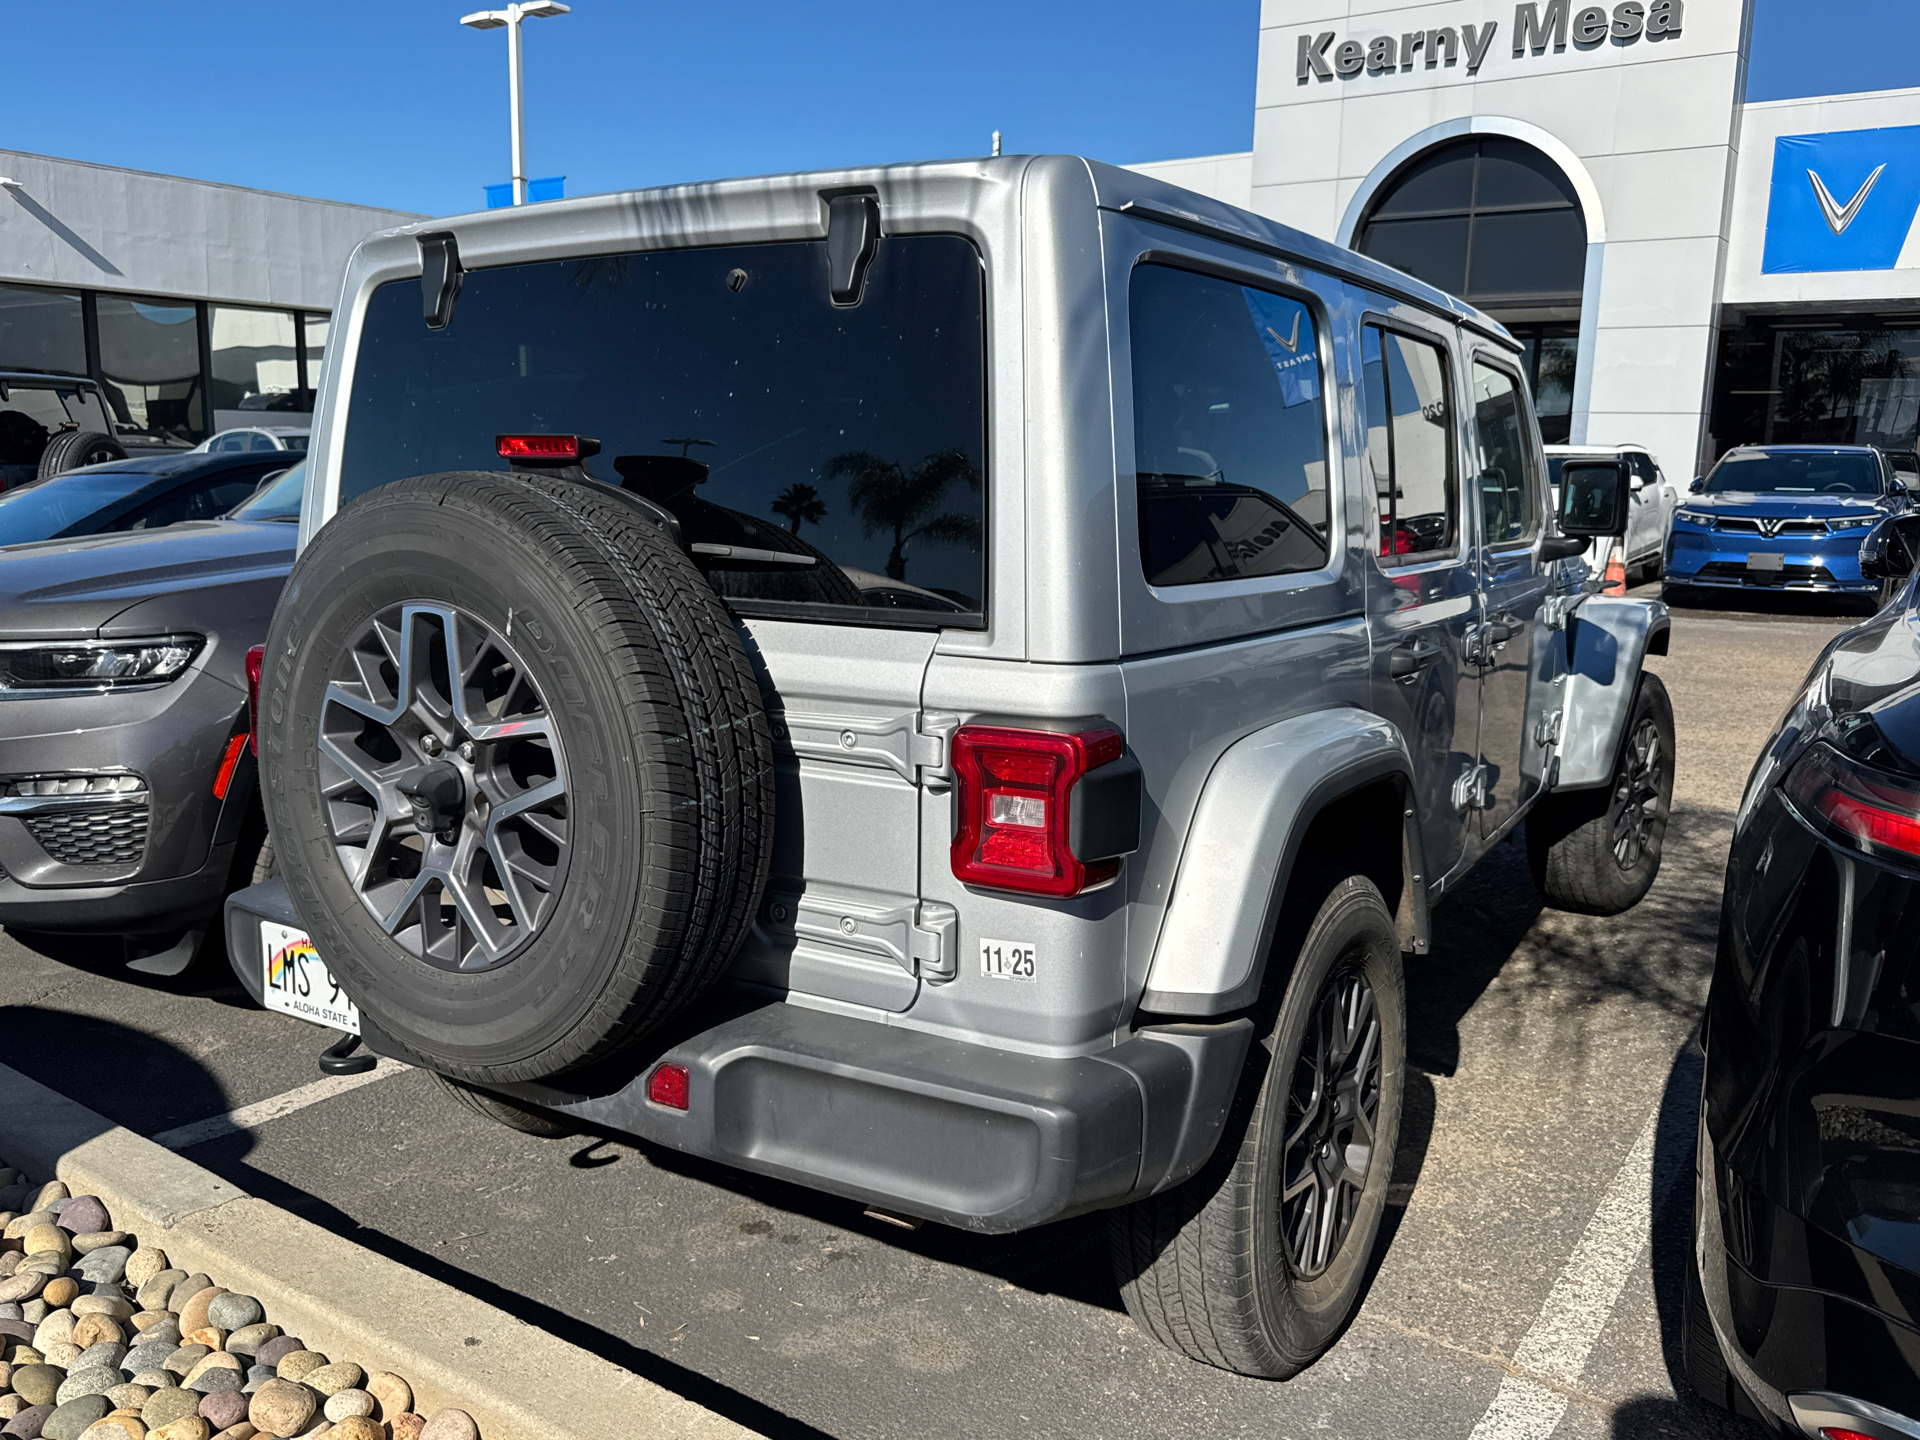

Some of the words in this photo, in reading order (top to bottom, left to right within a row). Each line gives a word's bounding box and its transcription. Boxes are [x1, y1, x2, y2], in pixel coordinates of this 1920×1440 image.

[1296, 20, 1499, 86] Kearny
[1511, 0, 1684, 60] Mesa
[268, 943, 310, 997] LMS
[982, 945, 1002, 973] 11
[1012, 948, 1035, 977] 25
[293, 1001, 320, 1017] ALOHA
[322, 1009, 348, 1025] STATE
